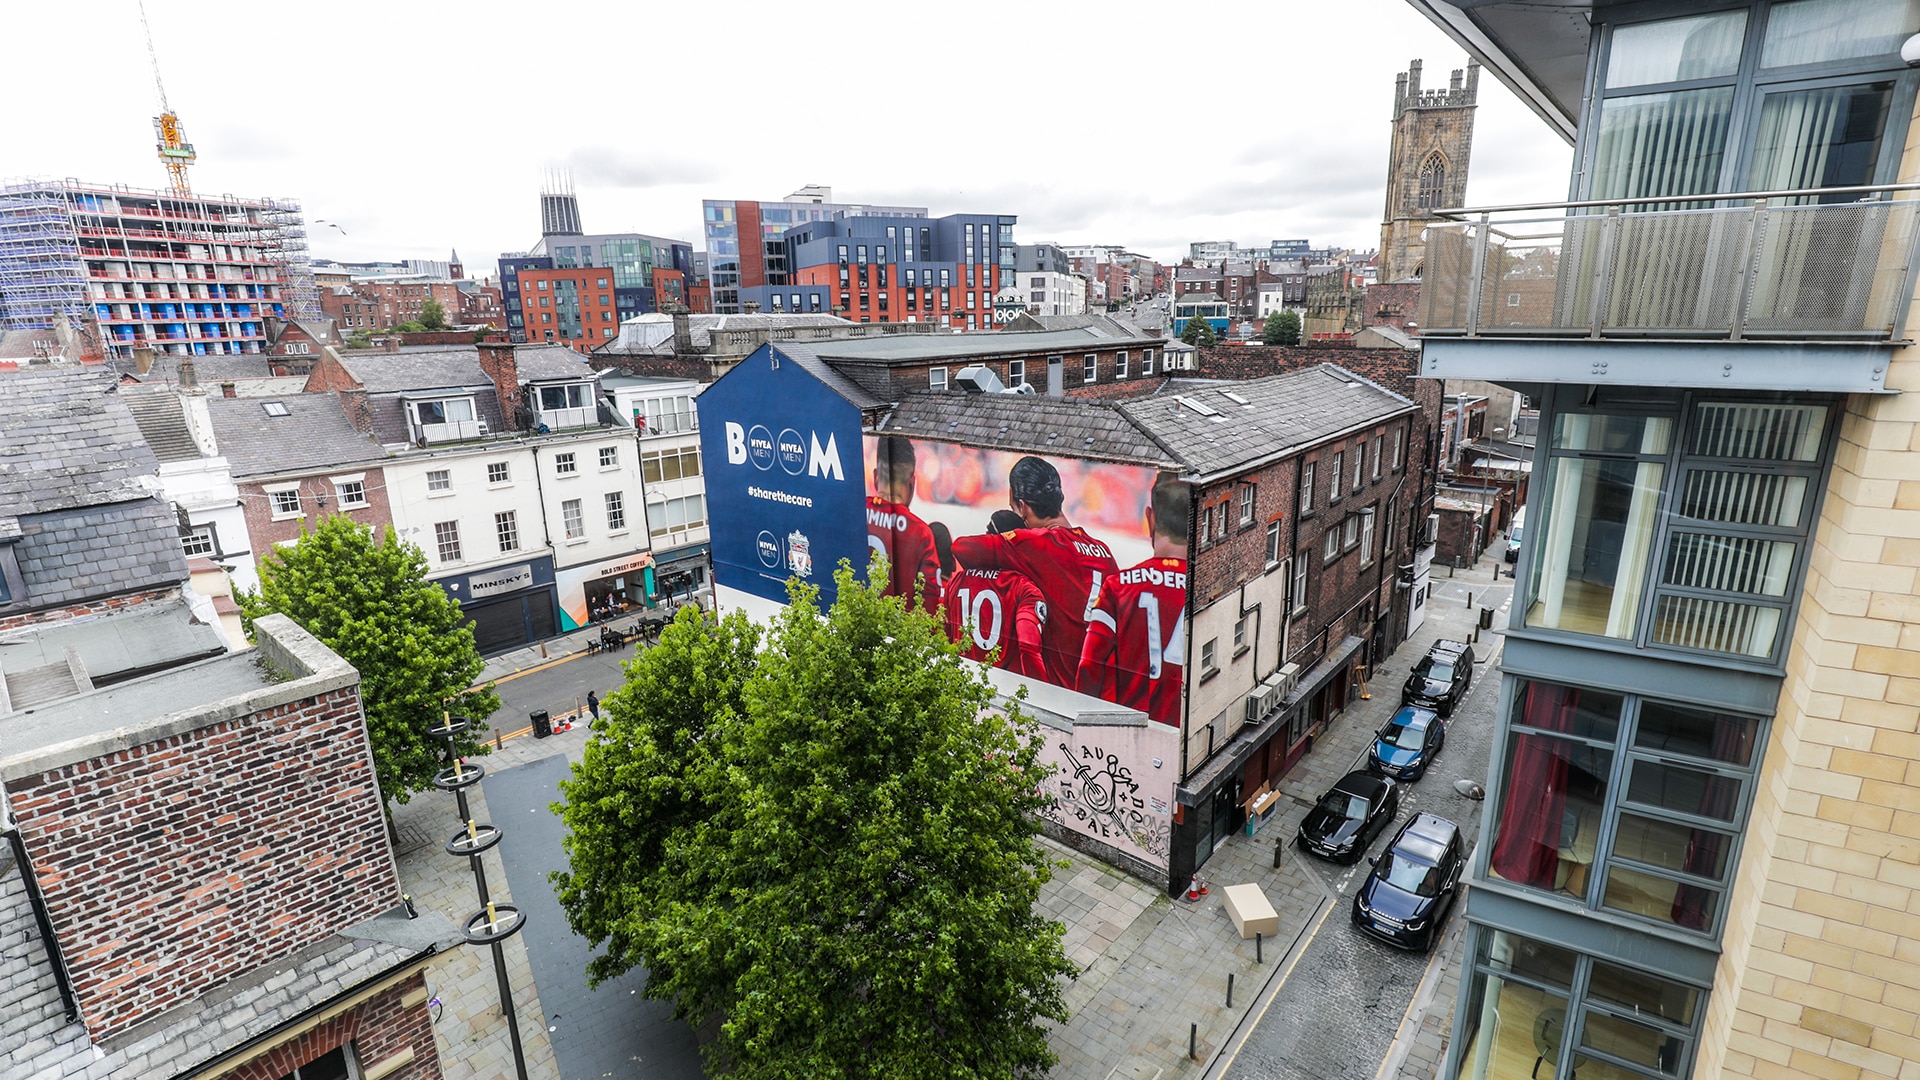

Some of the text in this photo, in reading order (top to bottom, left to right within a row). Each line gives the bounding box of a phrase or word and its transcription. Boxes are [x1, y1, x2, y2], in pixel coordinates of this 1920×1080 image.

[750, 438, 772, 450] NIVEA
[780, 442, 803, 454] NIVEA
[753, 448, 771, 458] MEN
[783, 452, 801, 463] MEN
[748, 485, 813, 508] #sharethecare
[867, 508, 907, 532] MINO
[759, 540, 777, 552] NIVEA
[1073, 540, 1111, 559] VIRGIL
[761, 549, 776, 559] MEN
[613, 563, 629, 573] STREET
[629, 560, 646, 569] COFFEE
[957, 588, 1003, 651] 10
